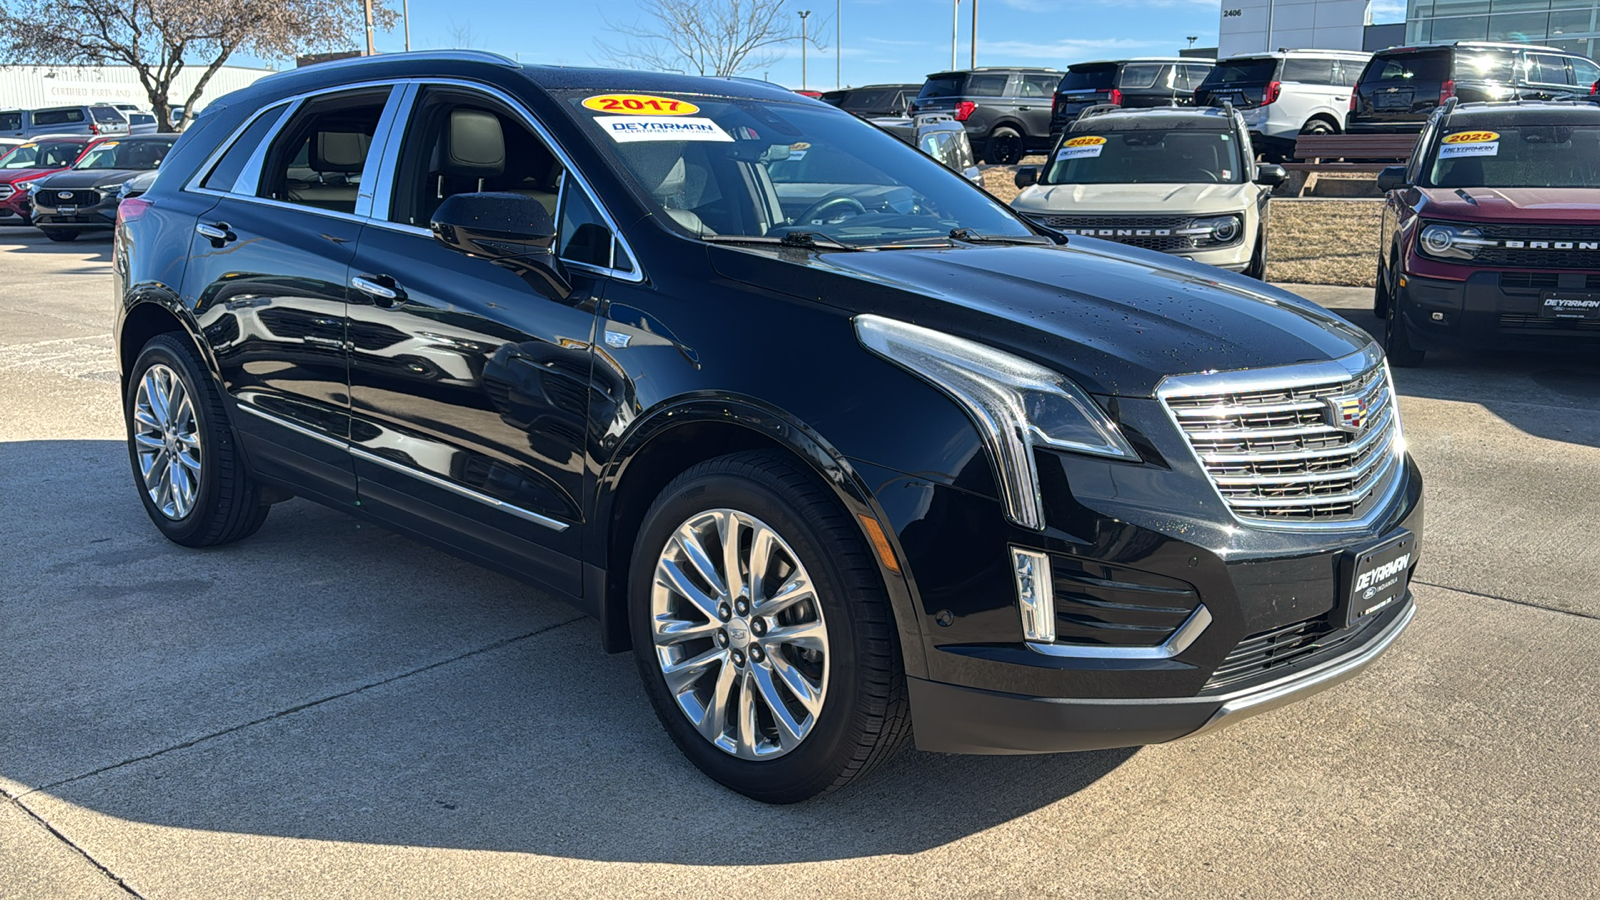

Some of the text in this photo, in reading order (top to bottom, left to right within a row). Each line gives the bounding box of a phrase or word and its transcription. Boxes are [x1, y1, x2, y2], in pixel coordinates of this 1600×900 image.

[1223, 9, 1242, 17] 2406
[51, 86, 88, 96] CERTIFIED
[91, 88, 113, 97] PARTS
[115, 88, 131, 97] AND
[599, 98, 681, 111] 2017
[612, 122, 714, 131] DEYARMAN
[1068, 137, 1104, 146] 2025
[1447, 132, 1494, 143] 2025
[1505, 241, 1598, 250] BRON
[1543, 299, 1600, 308] DEYARMAN
[1354, 552, 1411, 593] DEYARMAN
